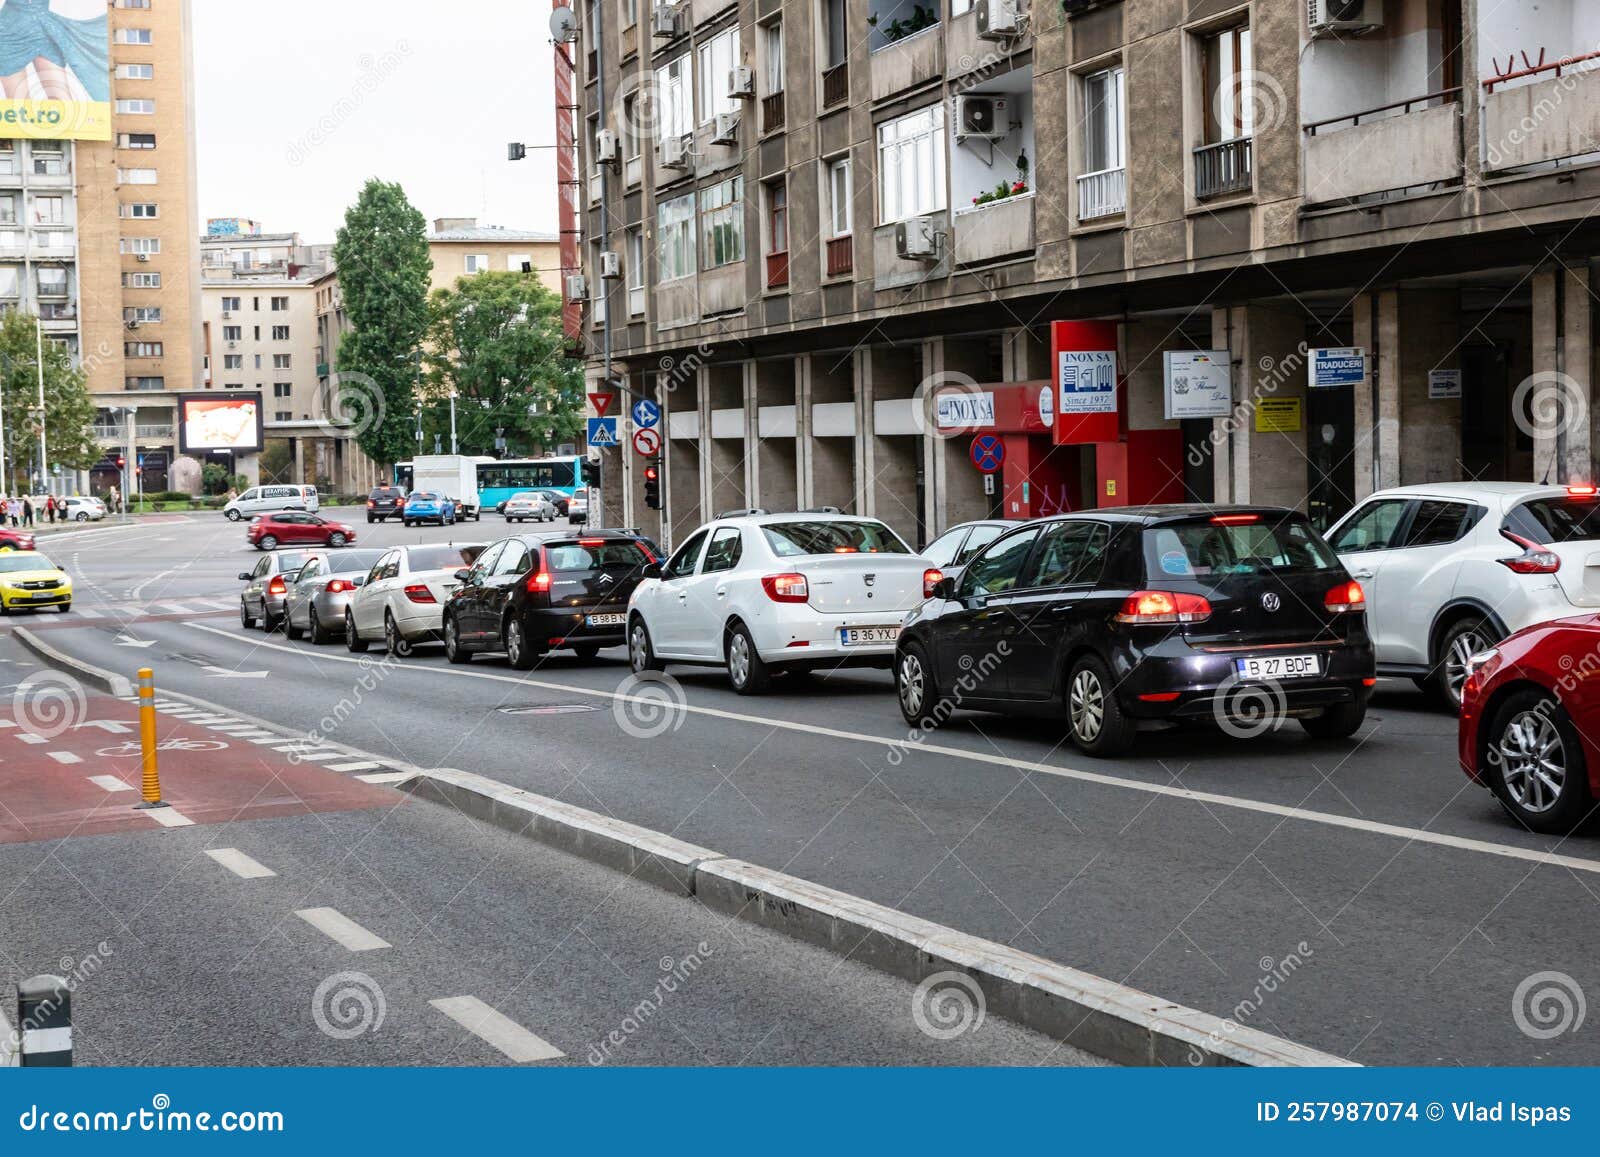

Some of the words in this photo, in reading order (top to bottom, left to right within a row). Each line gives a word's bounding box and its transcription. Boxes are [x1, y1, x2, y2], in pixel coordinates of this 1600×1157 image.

[0, 107, 60, 124] et.ro
[1065, 353, 1093, 362] INOX
[1317, 360, 1362, 369] TRADUCERI
[851, 630, 858, 640] B
[876, 629, 897, 639] YXJ
[1250, 661, 1260, 675] B
[1265, 660, 1279, 674] 27
[1285, 657, 1312, 672] BDF
